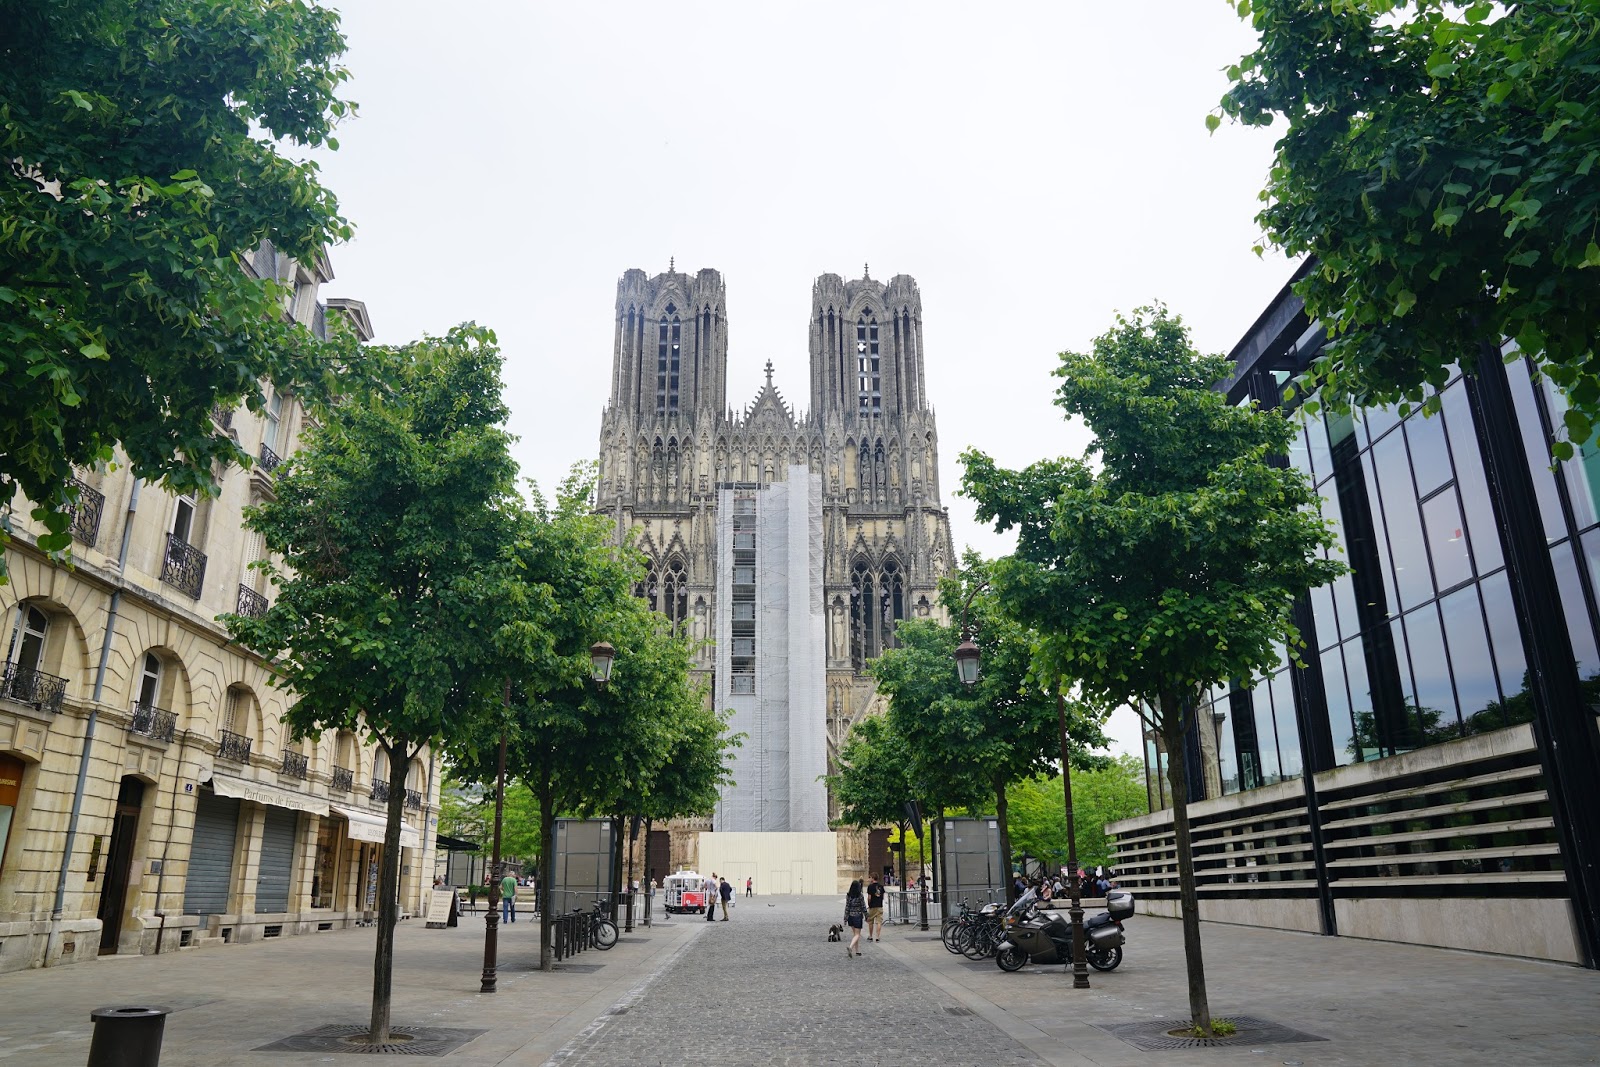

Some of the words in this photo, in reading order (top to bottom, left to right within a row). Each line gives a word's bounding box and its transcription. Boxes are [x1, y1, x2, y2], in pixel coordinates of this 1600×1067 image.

[244, 787, 274, 803] Parfums
[275, 795, 284, 805] de
[285, 797, 306, 809] France
